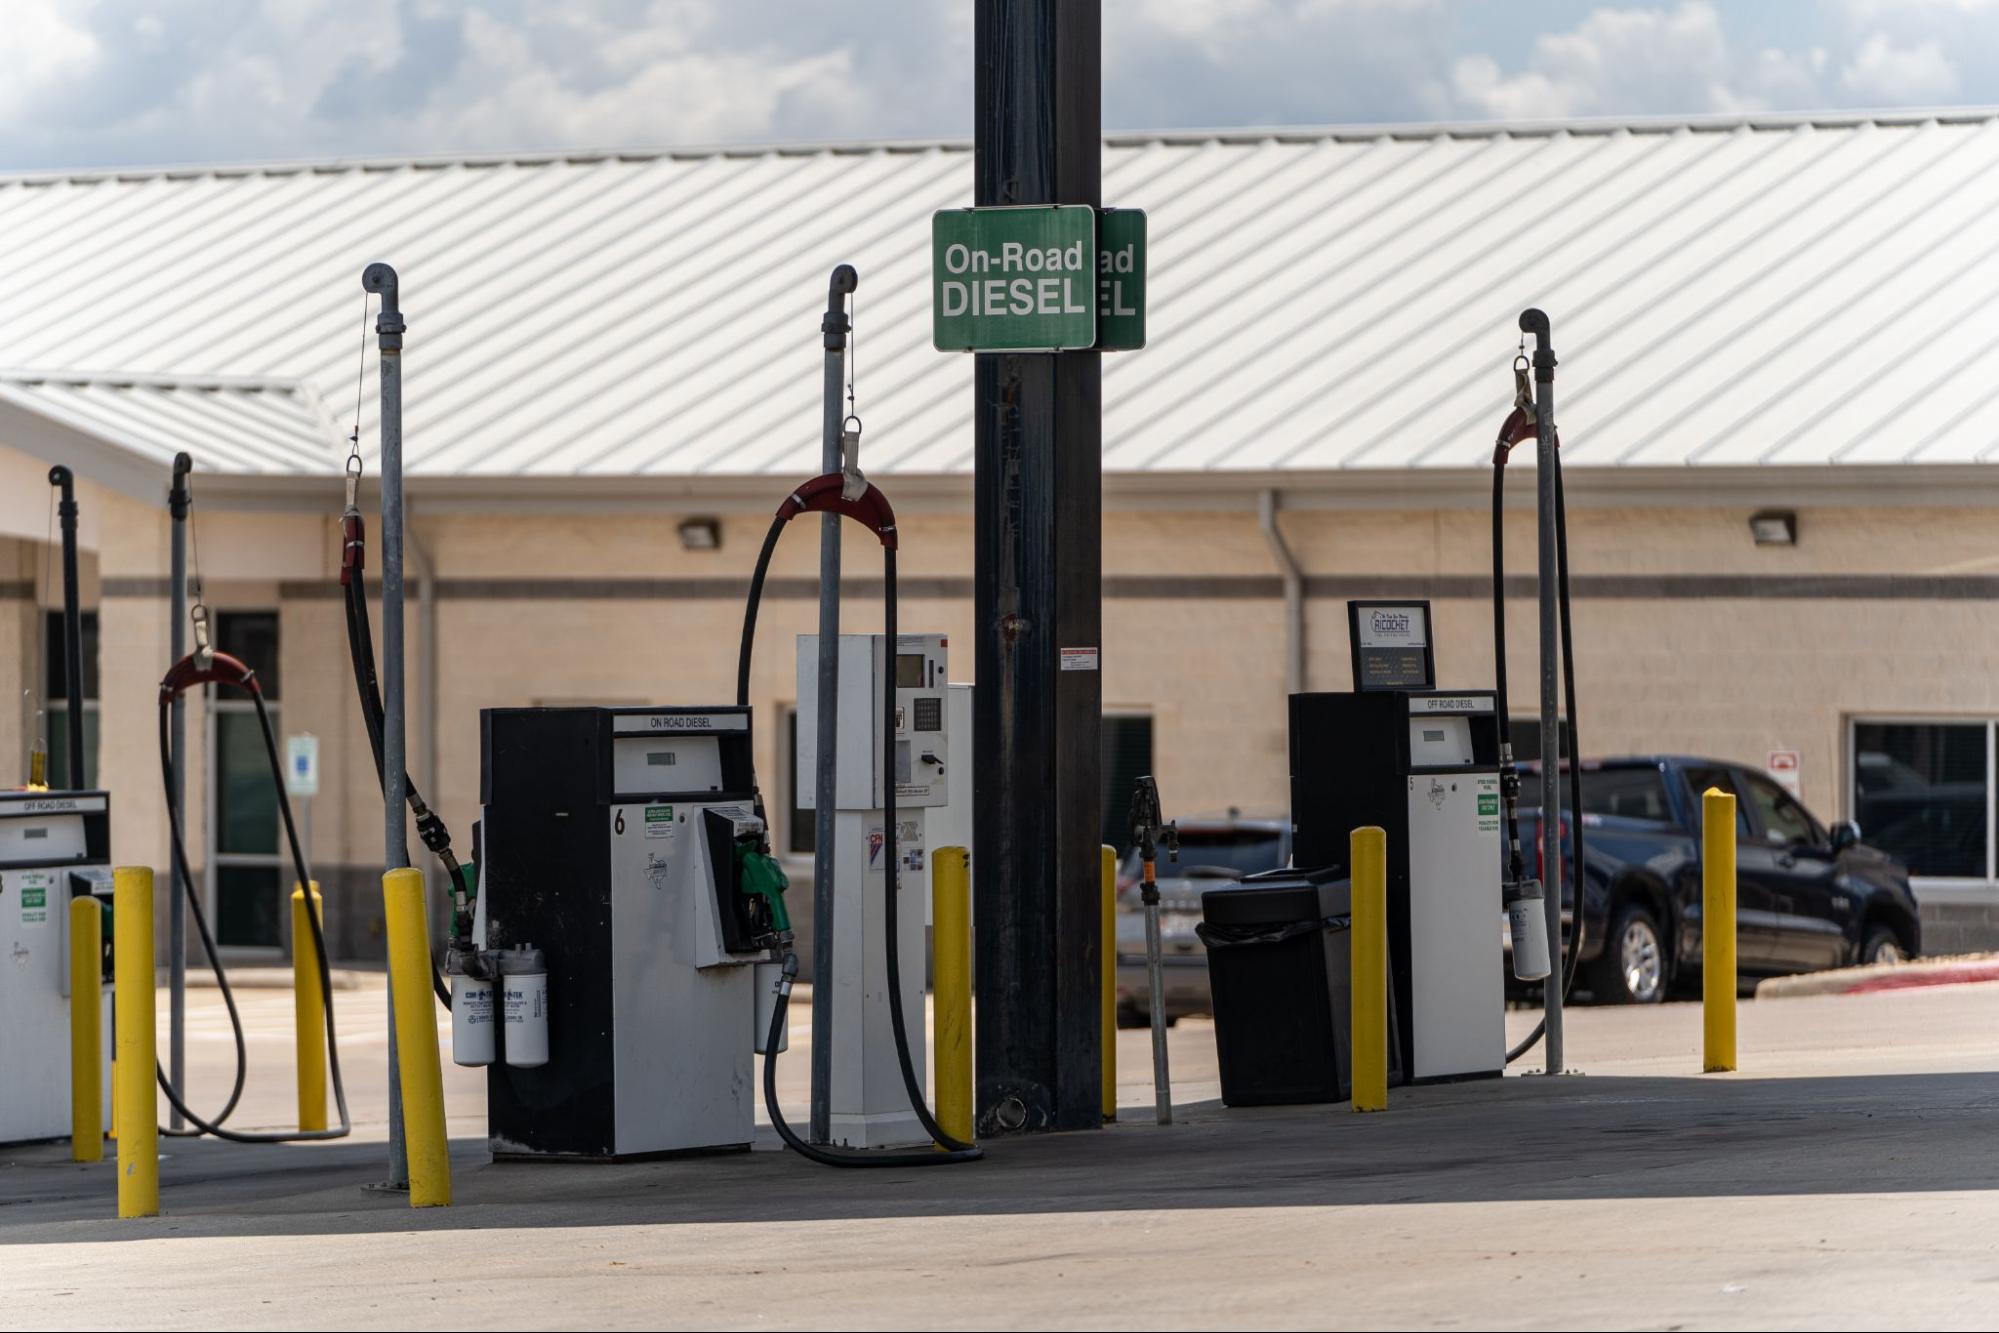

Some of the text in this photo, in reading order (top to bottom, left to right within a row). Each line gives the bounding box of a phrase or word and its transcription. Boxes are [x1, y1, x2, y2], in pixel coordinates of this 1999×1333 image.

[945, 240, 1082, 274] On-Road
[942, 278, 1086, 317] DIESEL
[1374, 619, 1410, 631] RICOCHET
[1427, 699, 1474, 709] OFF ROAD DIESEL
[650, 716, 712, 728] ON ROAD DIESEL
[614, 808, 626, 836] 6
